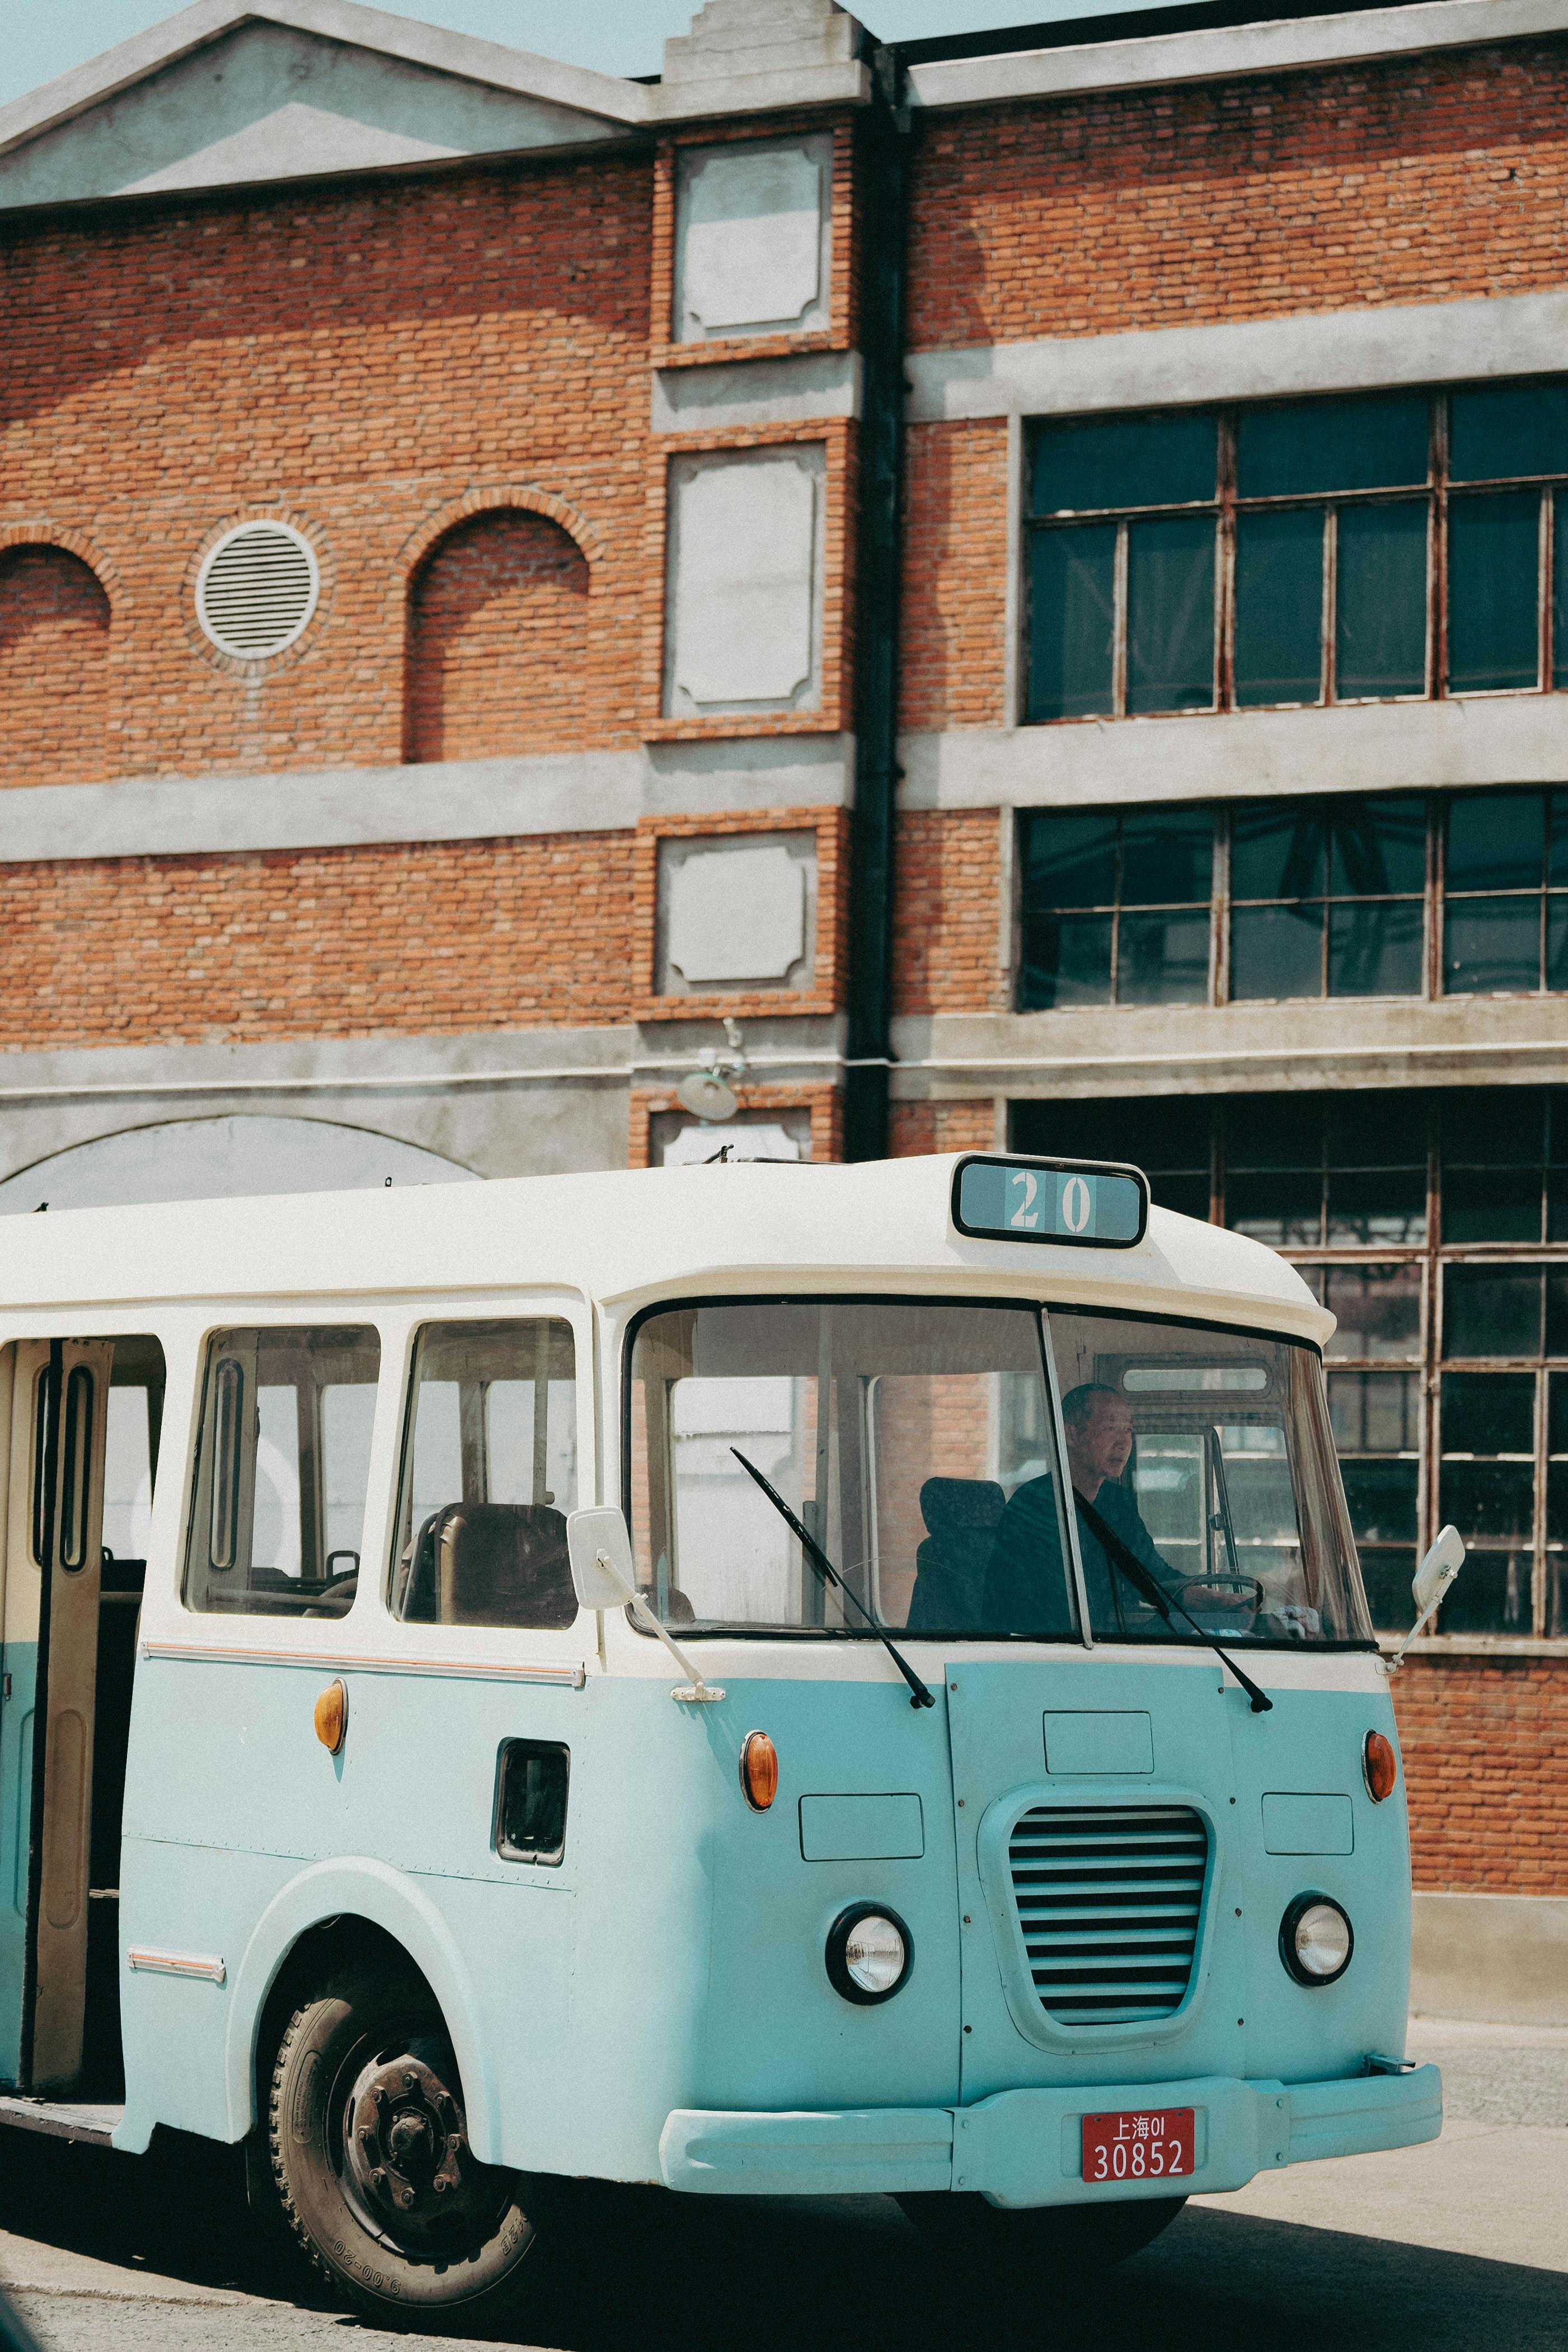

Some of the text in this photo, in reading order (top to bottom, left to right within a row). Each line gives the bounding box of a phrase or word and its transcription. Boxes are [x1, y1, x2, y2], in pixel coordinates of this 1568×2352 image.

[1010, 1172, 1090, 1232] 20
[1093, 2140, 1183, 2179] 30852
[334, 2240, 401, 2295] 9.00-20
